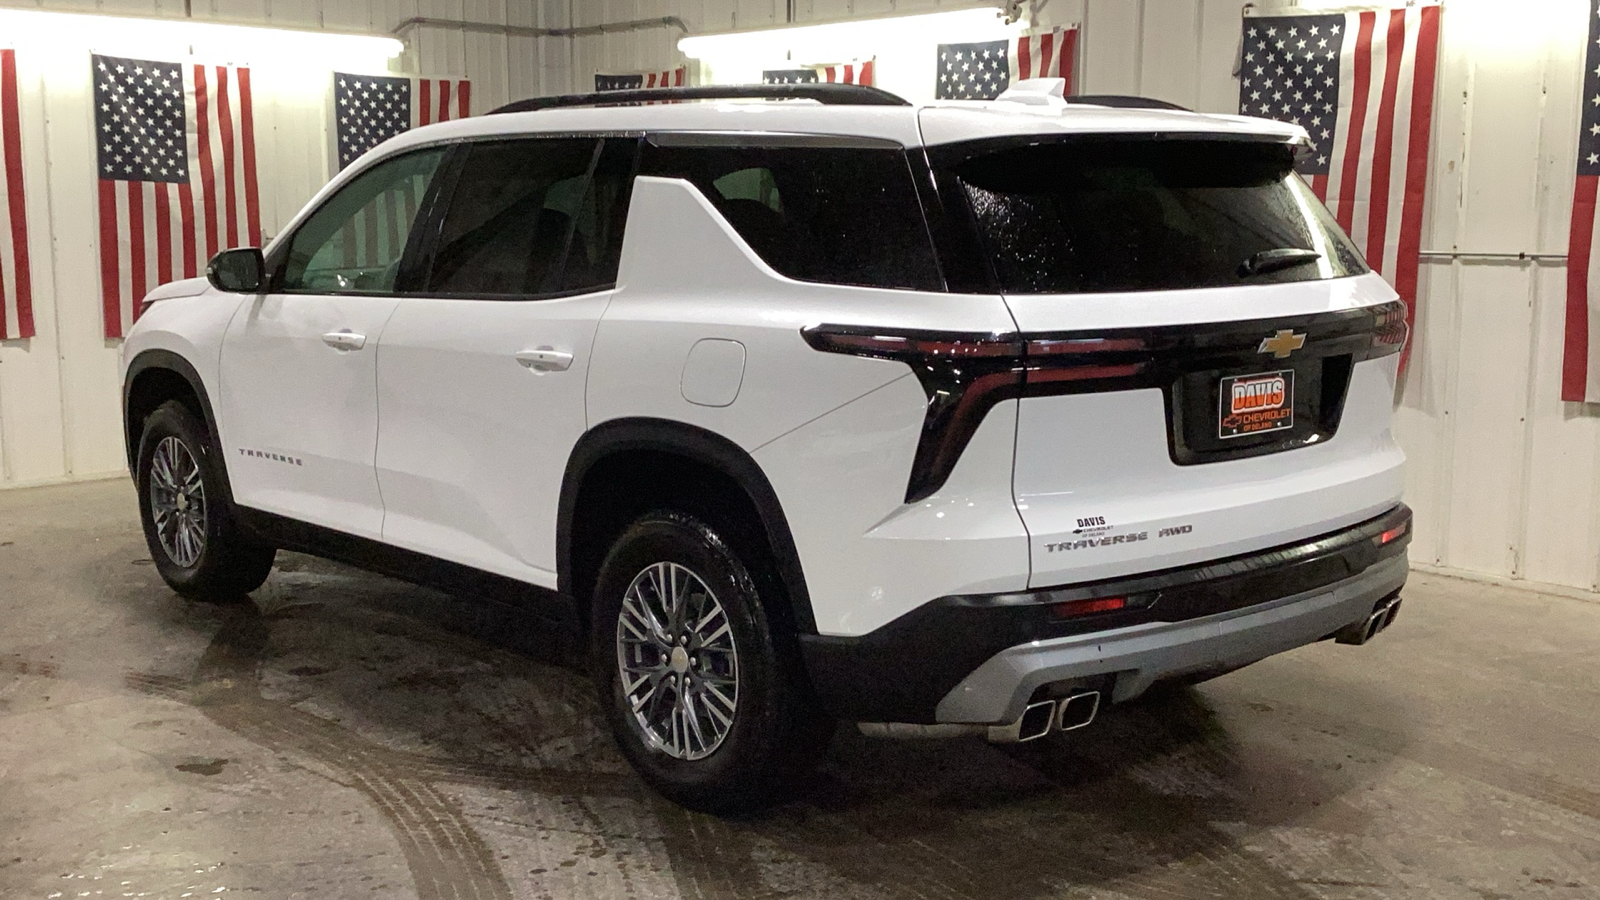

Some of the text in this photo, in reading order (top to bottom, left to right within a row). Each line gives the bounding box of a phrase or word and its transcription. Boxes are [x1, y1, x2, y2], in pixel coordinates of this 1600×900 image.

[1233, 380, 1283, 411] DAVIS
[1243, 409, 1291, 424] CHEVROLET
[239, 448, 302, 466] TRAVERSE
[1077, 516, 1106, 528] DAVIS
[1045, 524, 1193, 552] TRAVERSE AWD
